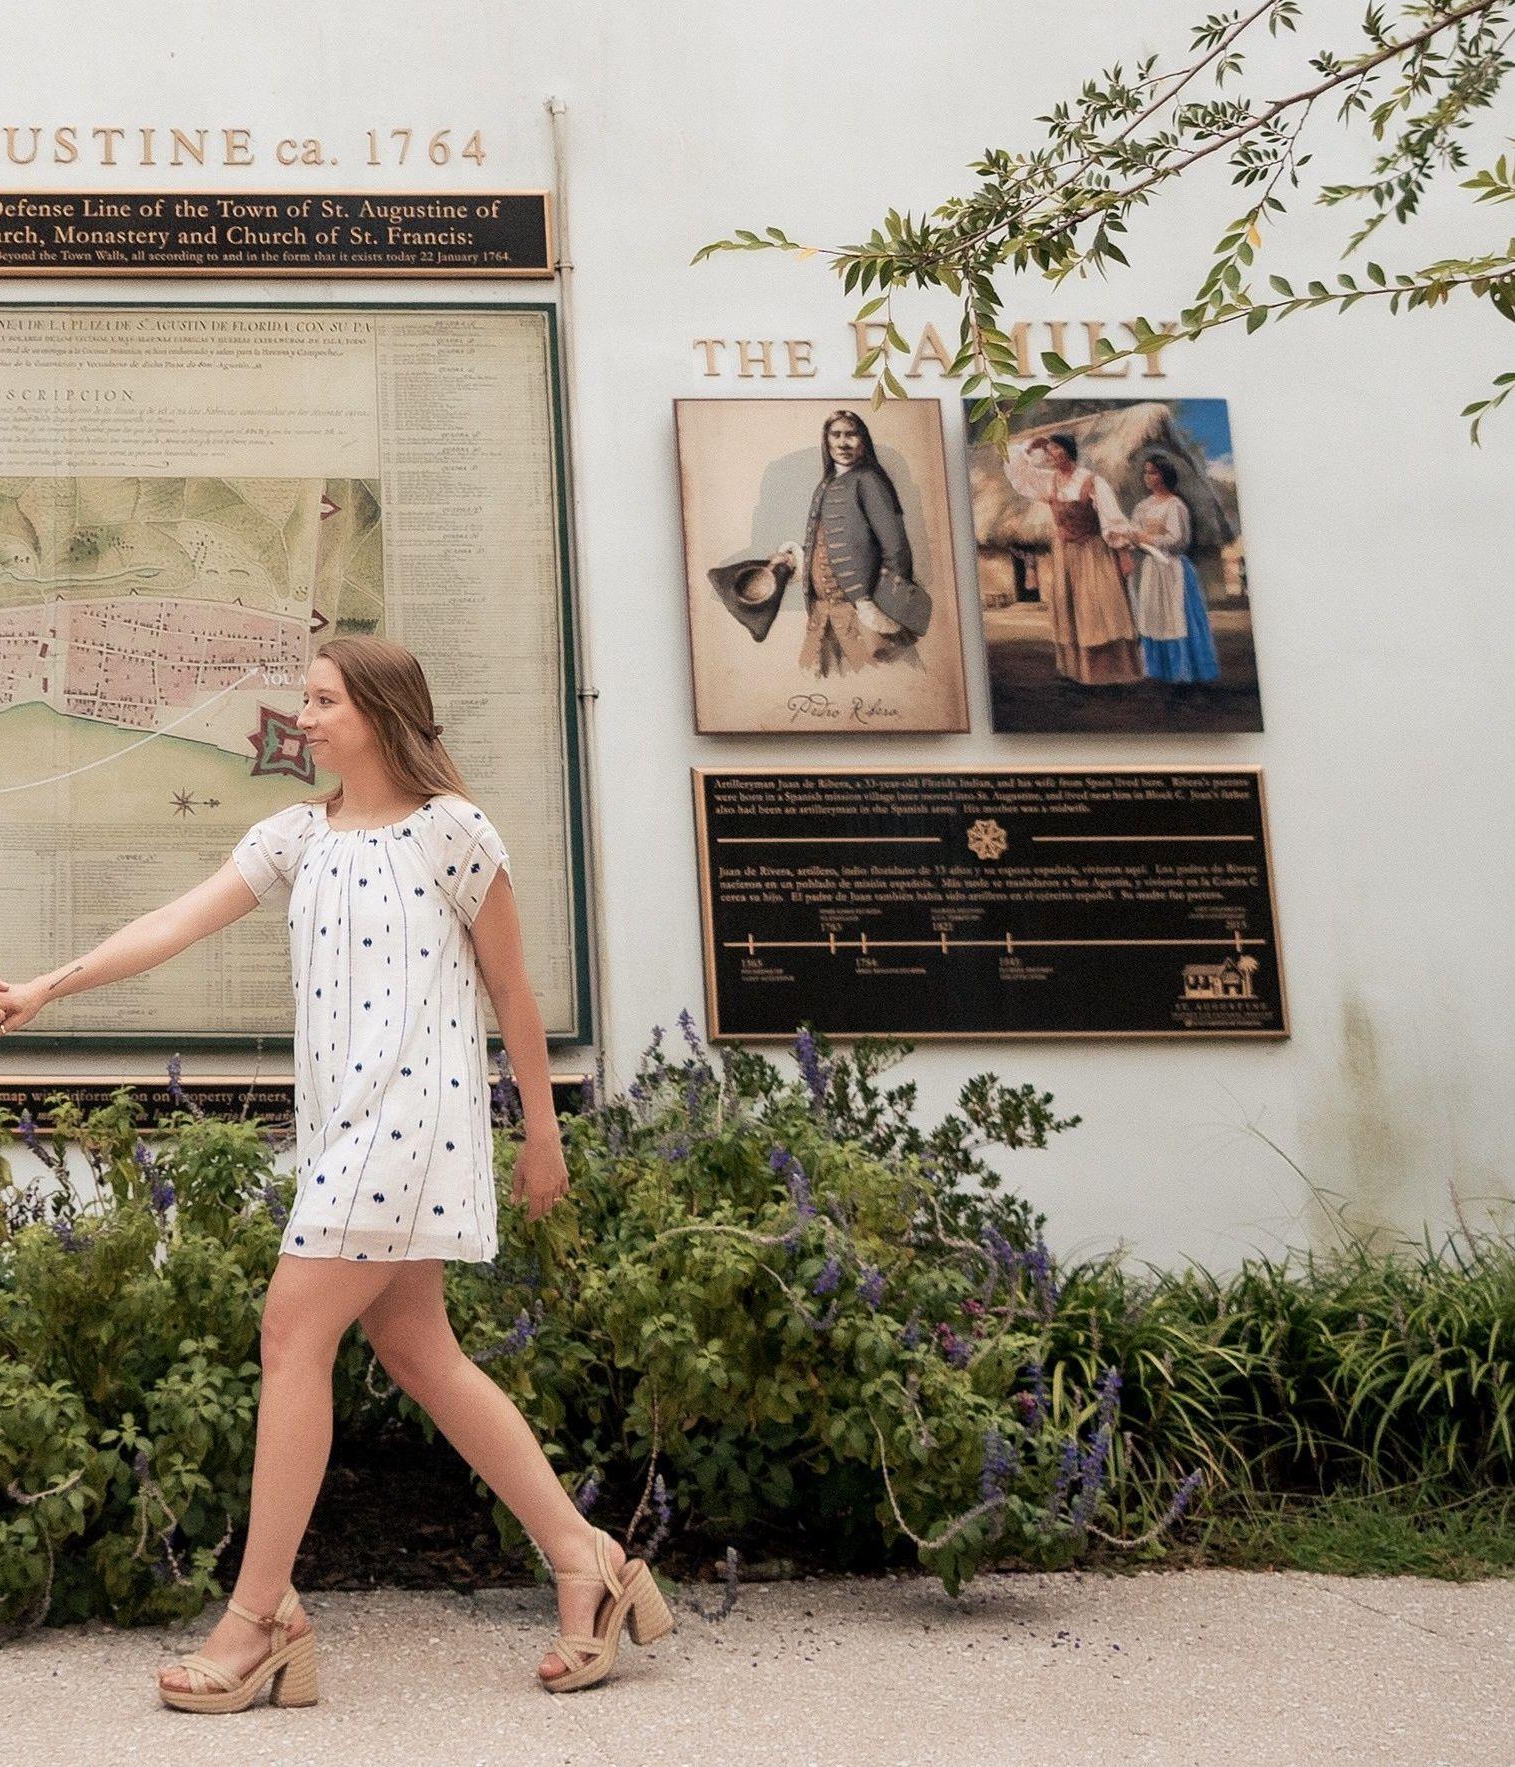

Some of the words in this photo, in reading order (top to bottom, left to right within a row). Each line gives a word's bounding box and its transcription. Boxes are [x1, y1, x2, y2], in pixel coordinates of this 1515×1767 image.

[275, 138, 338, 166] ca.
[366, 128, 487, 167] 1764
[82, 198, 131, 217] Line
[138, 198, 164, 217] of
[174, 198, 208, 218] the
[216, 199, 278, 218] Town
[286, 198, 312, 217] of
[320, 199, 349, 218] St.
[358, 199, 468, 224] Augustine
[475, 199, 501, 218] of
[53, 225, 169, 250] Monastery
[177, 224, 217, 244] and
[226, 225, 306, 245] Church
[314, 225, 340, 244] of
[349, 226, 378, 245] St.
[386, 226, 473, 245] Francis:
[38, 249, 57, 260] the
[59, 250, 92, 261] Town
[94, 249, 128, 261] Walls,
[131, 250, 145, 260] all
[148, 249, 203, 264] according
[206, 252, 219, 261] to
[222, 250, 243, 261] and
[245, 251, 258, 261] in
[260, 250, 279, 261] the
[282, 250, 311, 261] form
[313, 250, 336, 261] that
[339, 251, 348, 261] it
[350, 252, 382, 261] exists
[385, 250, 416, 264] today
[419, 250, 434, 261] 22
[436, 251, 478, 264] January
[483, 250, 512, 262] 1764.
[692, 337, 818, 378] THE
[152, 1093, 171, 1103] on
